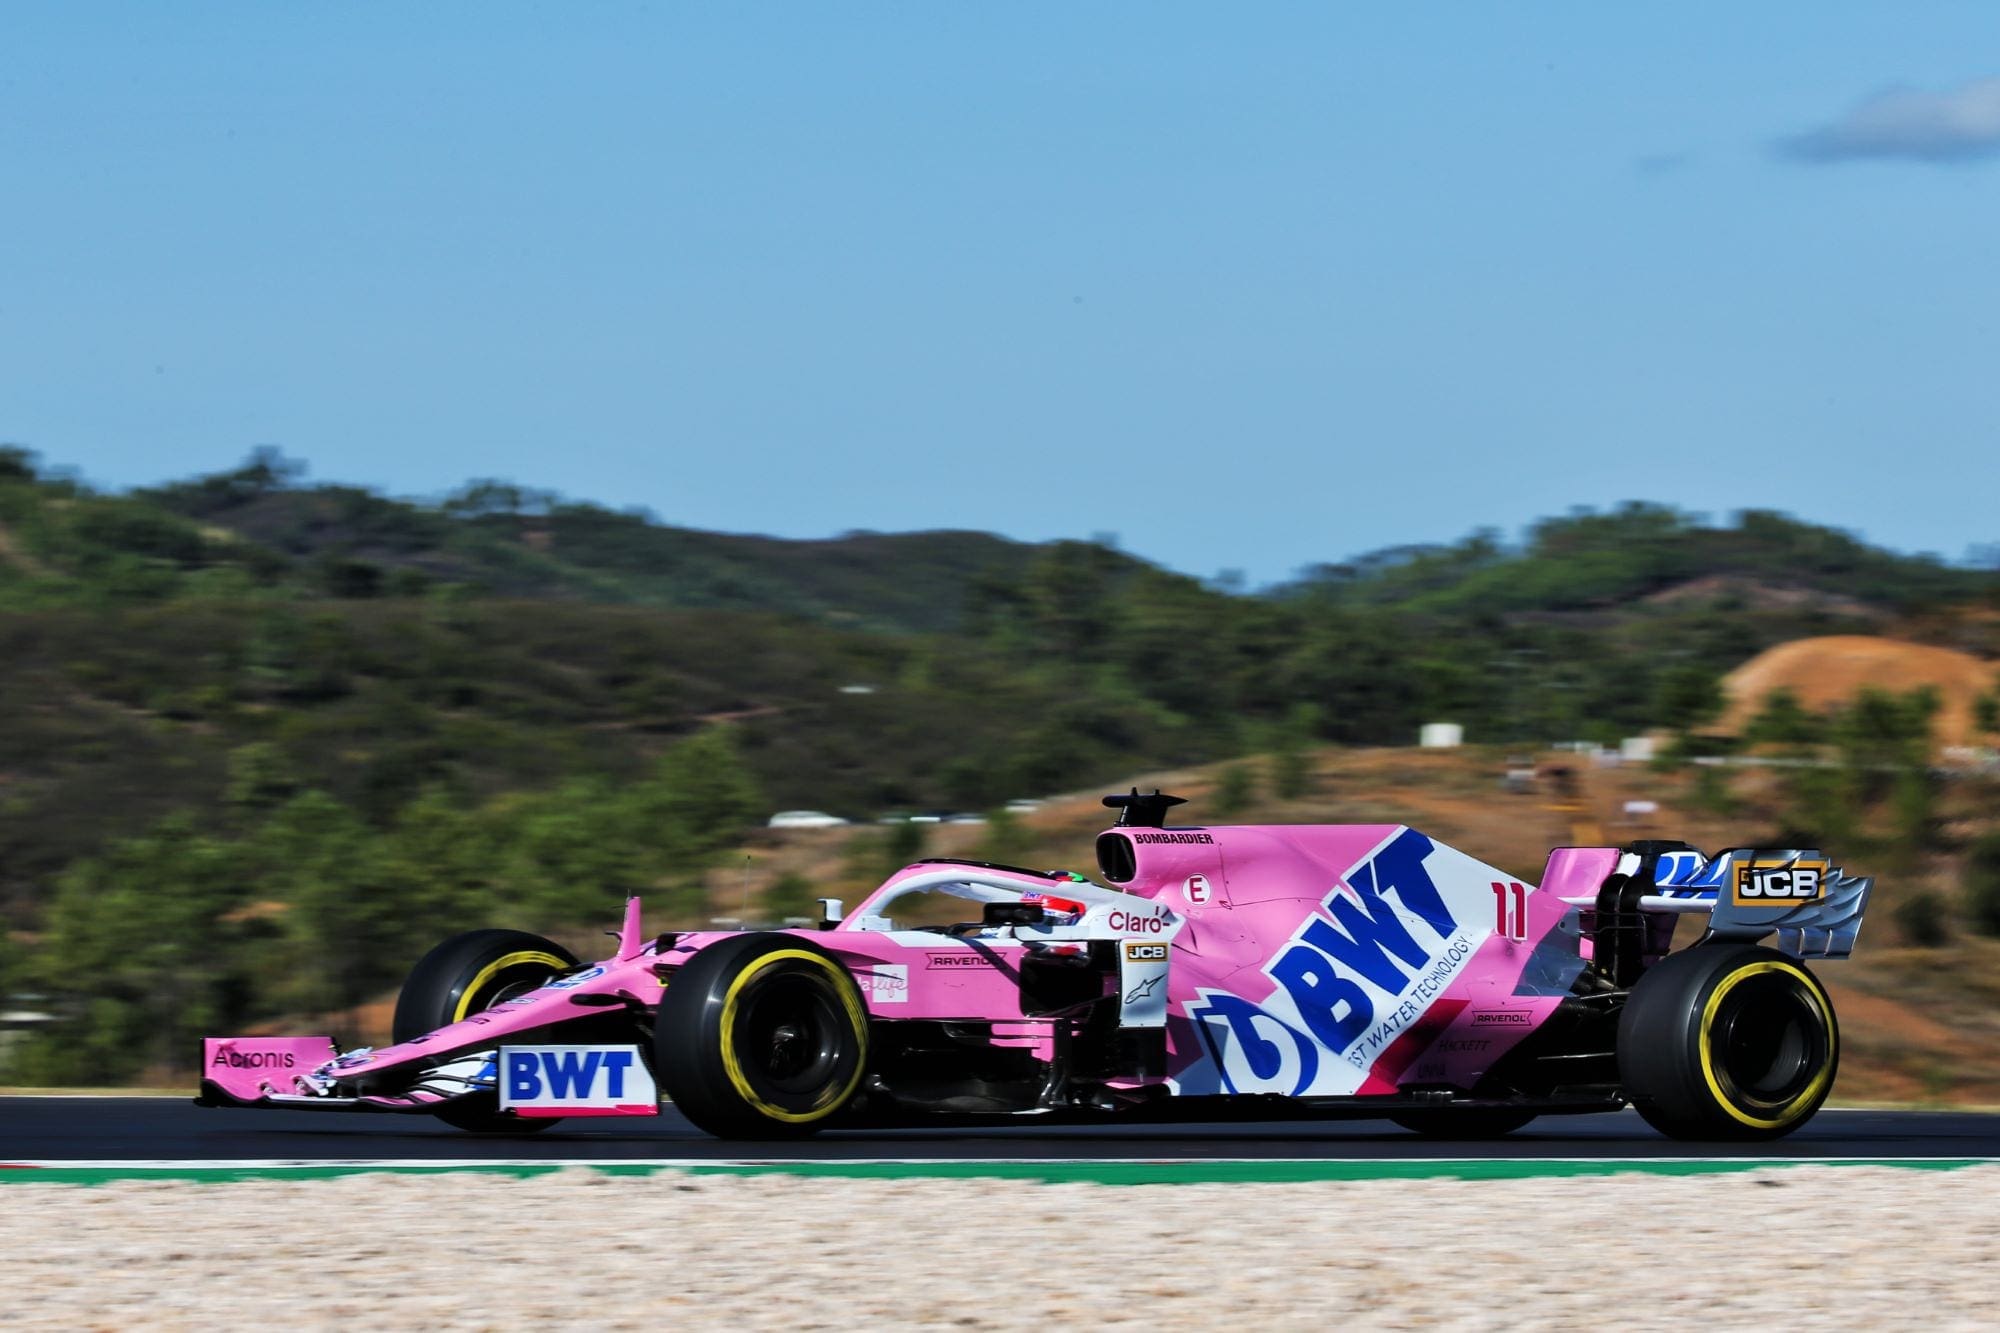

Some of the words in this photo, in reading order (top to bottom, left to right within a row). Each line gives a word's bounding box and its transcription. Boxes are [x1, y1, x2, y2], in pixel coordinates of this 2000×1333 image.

[1133, 833, 1215, 845] BOMBARDIER
[1189, 877, 1205, 903] E
[1740, 869, 1819, 897] JCB
[1108, 910, 1162, 934] Claro
[1490, 881, 1526, 939] 11
[1129, 946, 1165, 959] JCB
[1269, 827, 1458, 1055] BWT
[933, 956, 994, 966] RAVENO
[1366, 1000, 1419, 1049] WATER
[1410, 935, 1473, 1004] TECHNOLOGY
[1477, 1014, 1527, 1023] RAVENOL
[211, 1045, 295, 1069] Acronis
[508, 1051, 633, 1100] BWT
